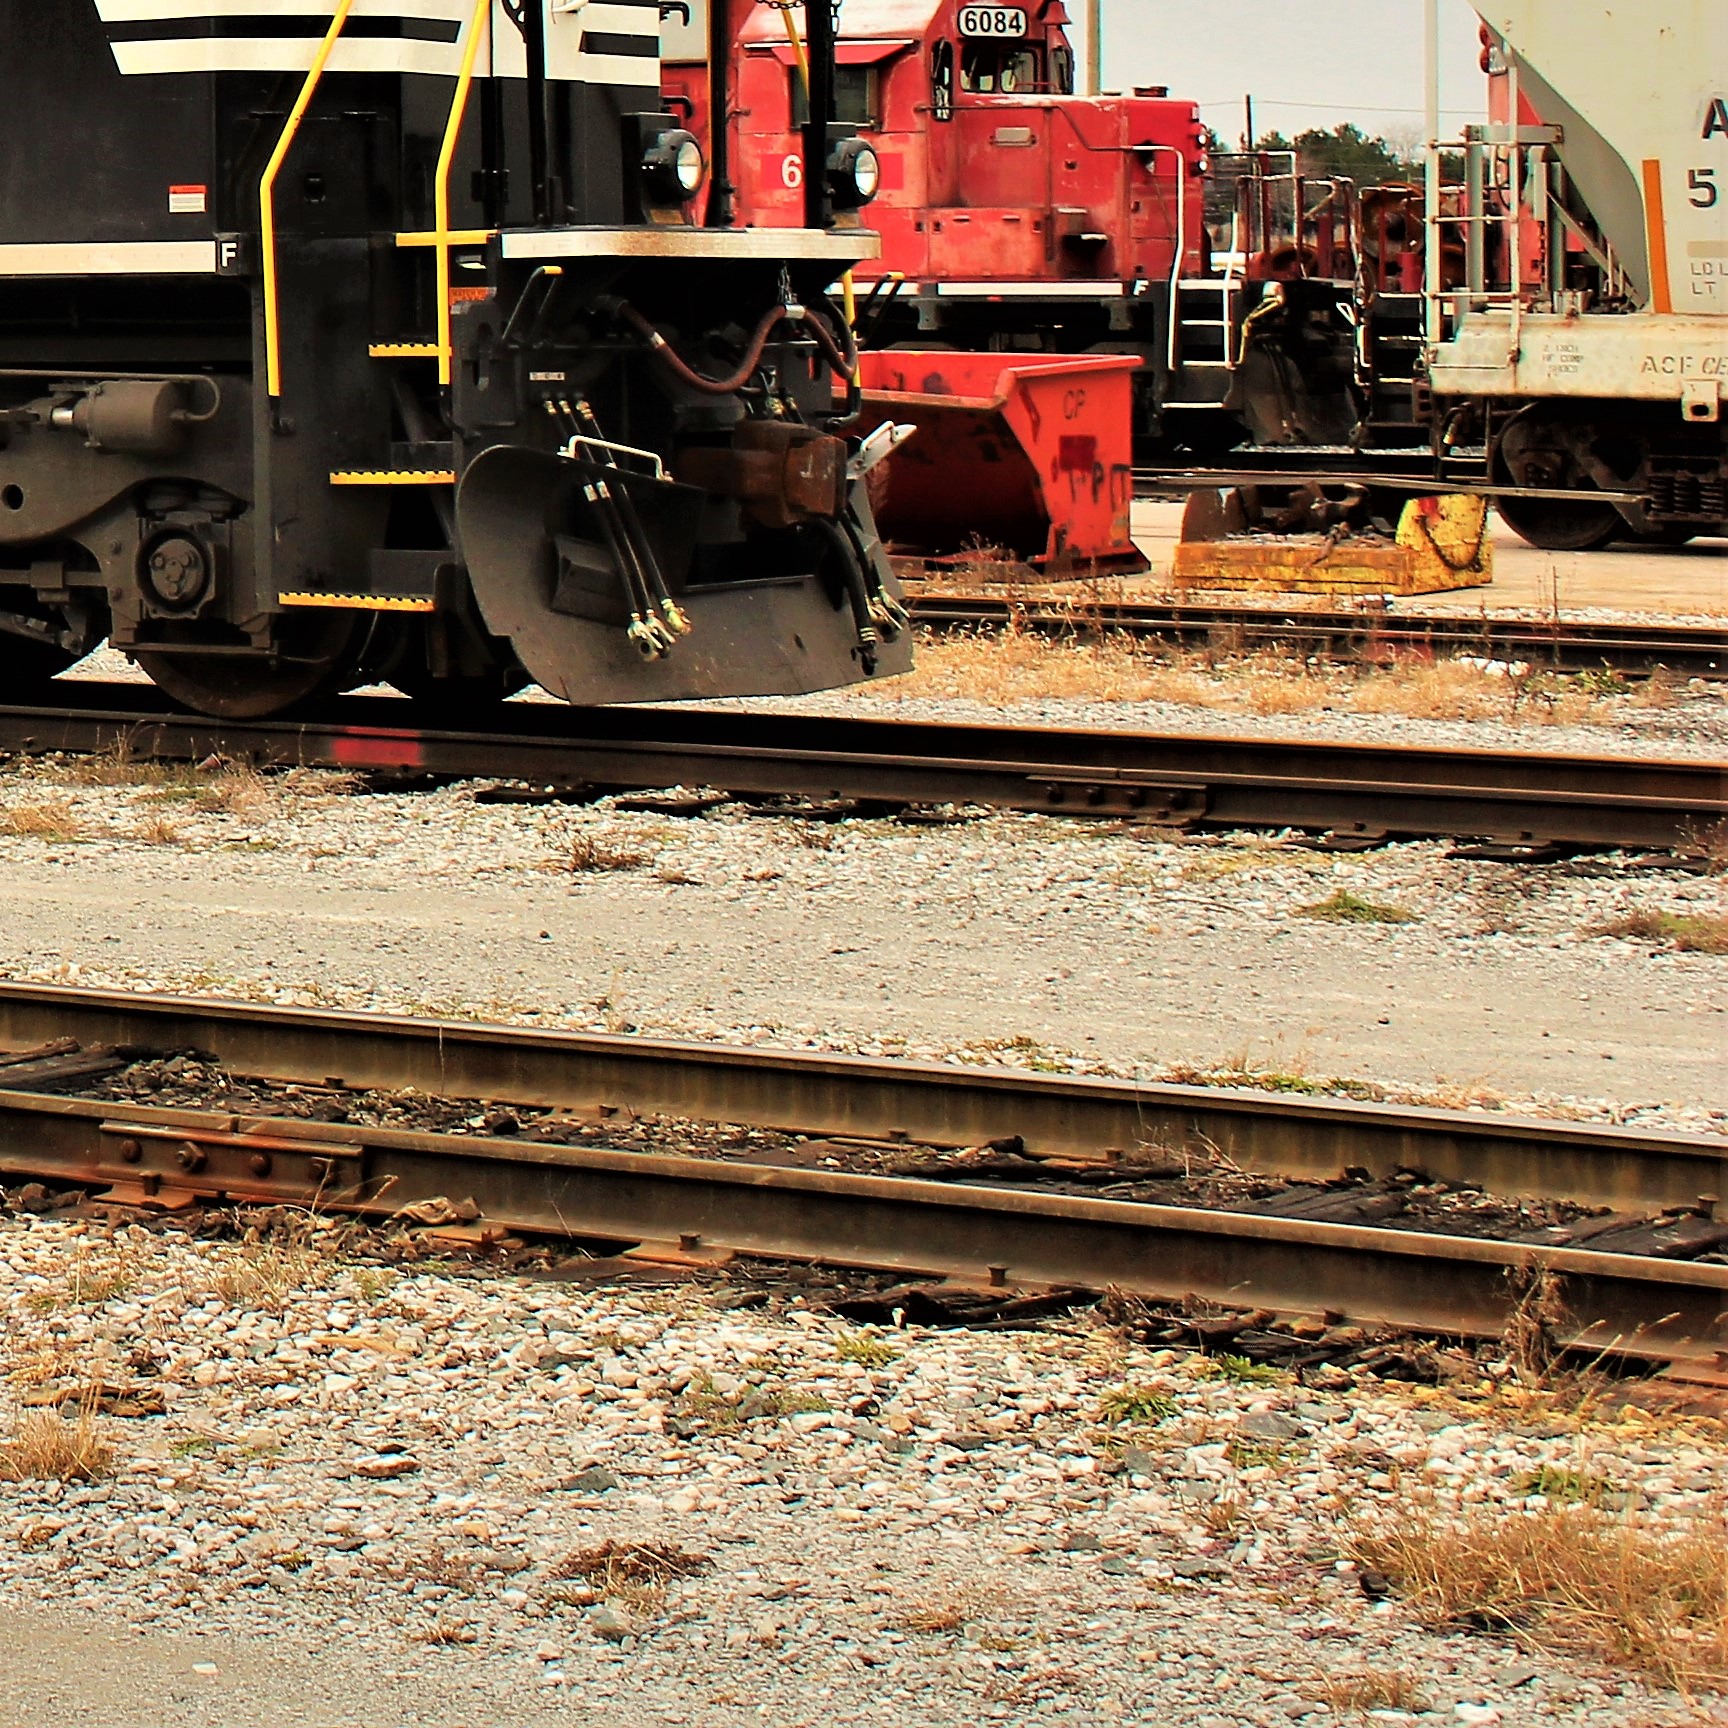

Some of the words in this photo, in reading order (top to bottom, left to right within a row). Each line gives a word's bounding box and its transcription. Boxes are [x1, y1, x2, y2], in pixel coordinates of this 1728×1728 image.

[965, 10, 1023, 33] 6084
[221, 242, 238, 268] F
[1133, 279, 1149, 297] F
[1640, 355, 1694, 375] ACF
